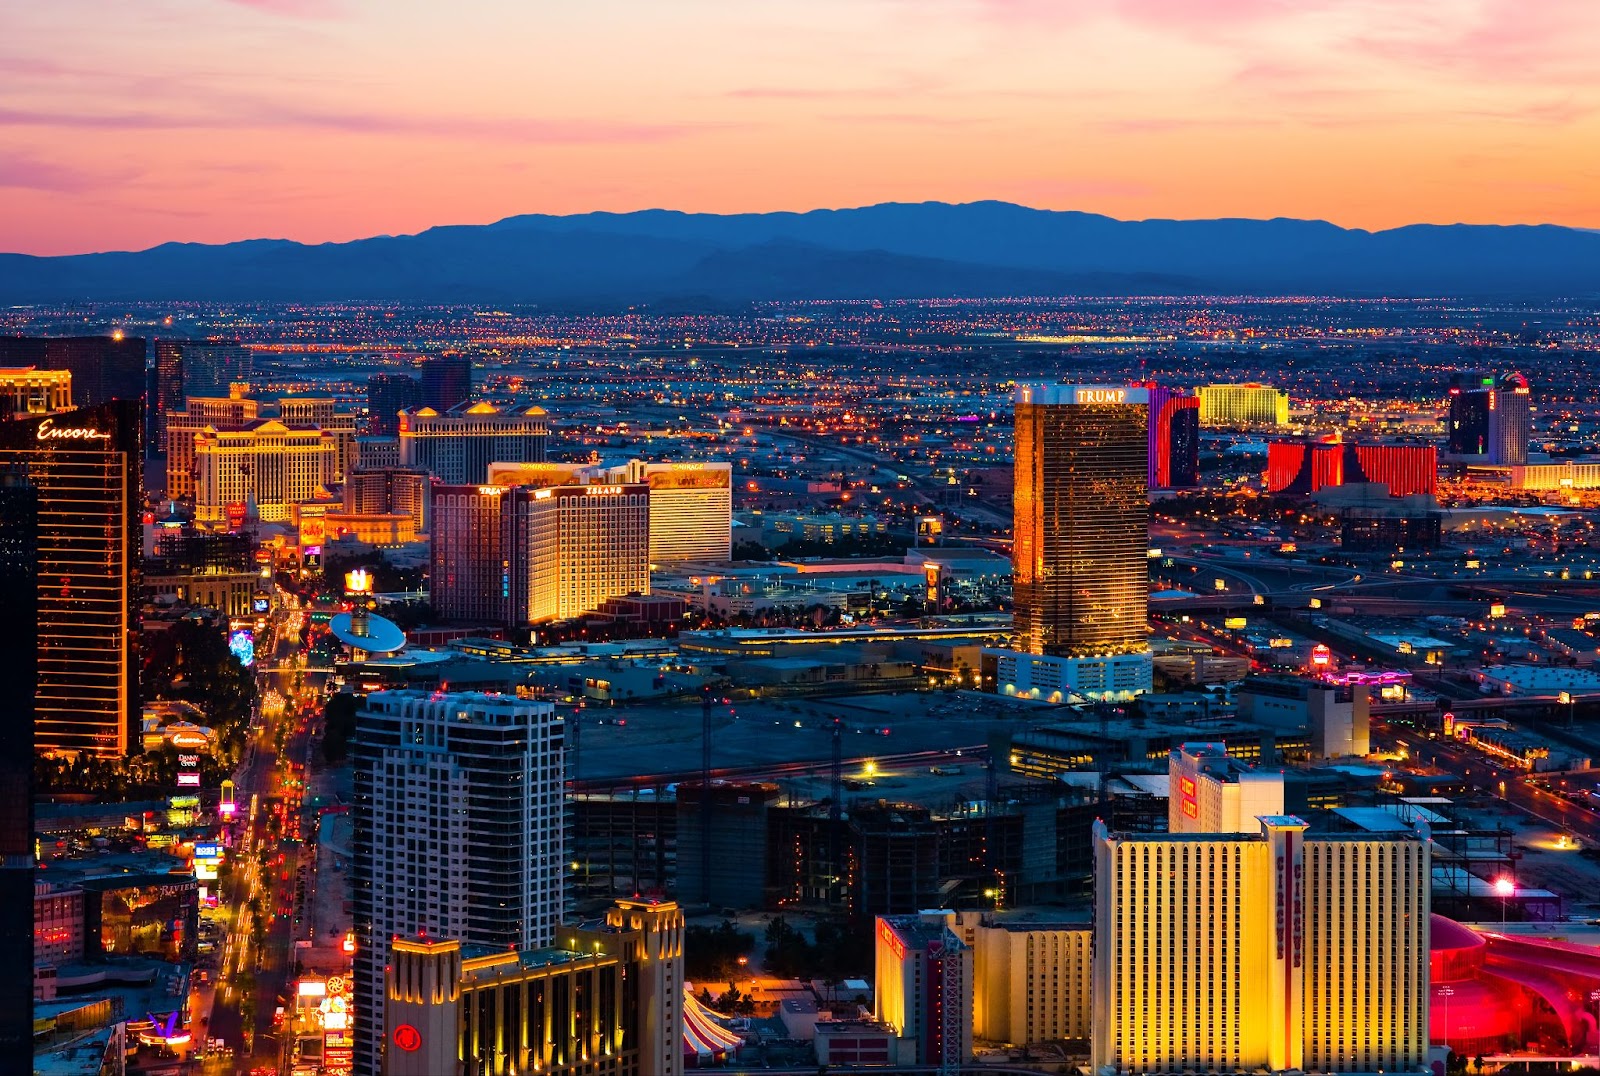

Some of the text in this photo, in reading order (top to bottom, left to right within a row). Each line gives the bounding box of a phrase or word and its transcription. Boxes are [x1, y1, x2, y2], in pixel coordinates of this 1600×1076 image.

[1078, 390, 1125, 402] TRUMP
[37, 418, 111, 440] Encore
[528, 463, 558, 471] MIRAGE
[586, 486, 622, 495] ISLAND
[178, 754, 199, 762] DANNY
[196, 846, 216, 856] ROSS
[1276, 856, 1284, 960] CIRCUS
[1293, 864, 1302, 968] CIRCUS
